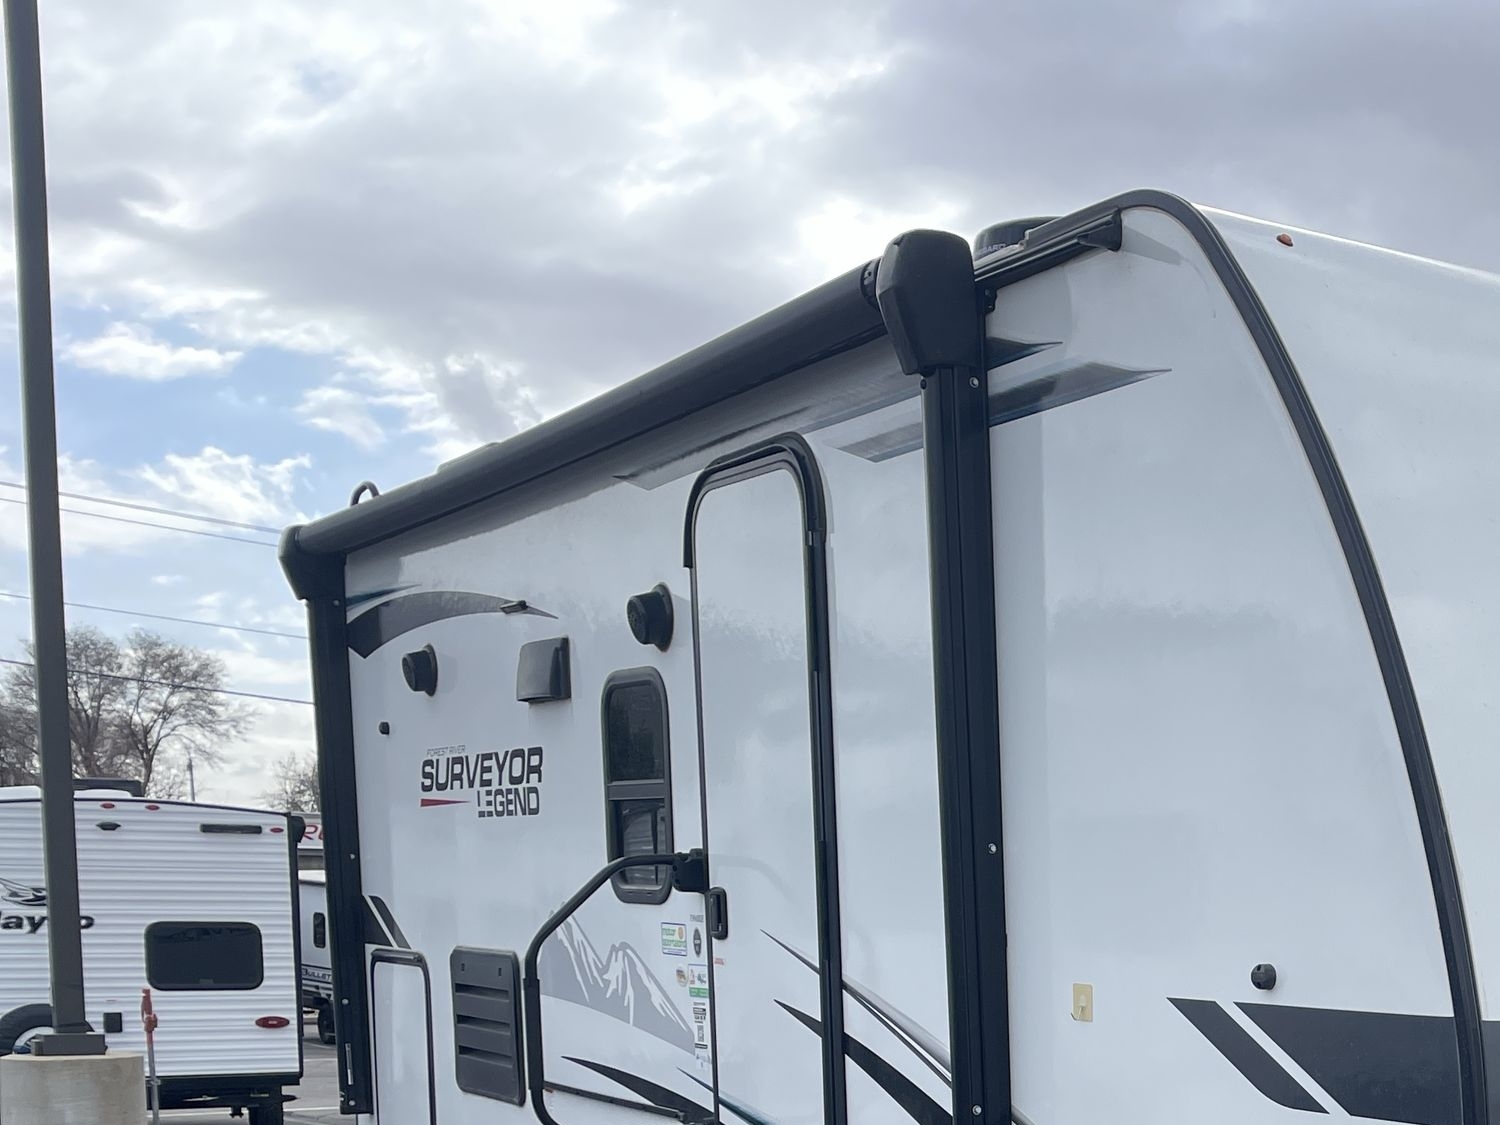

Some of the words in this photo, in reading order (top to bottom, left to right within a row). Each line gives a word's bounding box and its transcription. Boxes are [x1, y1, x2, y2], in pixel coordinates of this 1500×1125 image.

[421, 746, 543, 792] SURVEYOR
[477, 786, 540, 818] LEGEND
[0, 911, 95, 934] ayo
